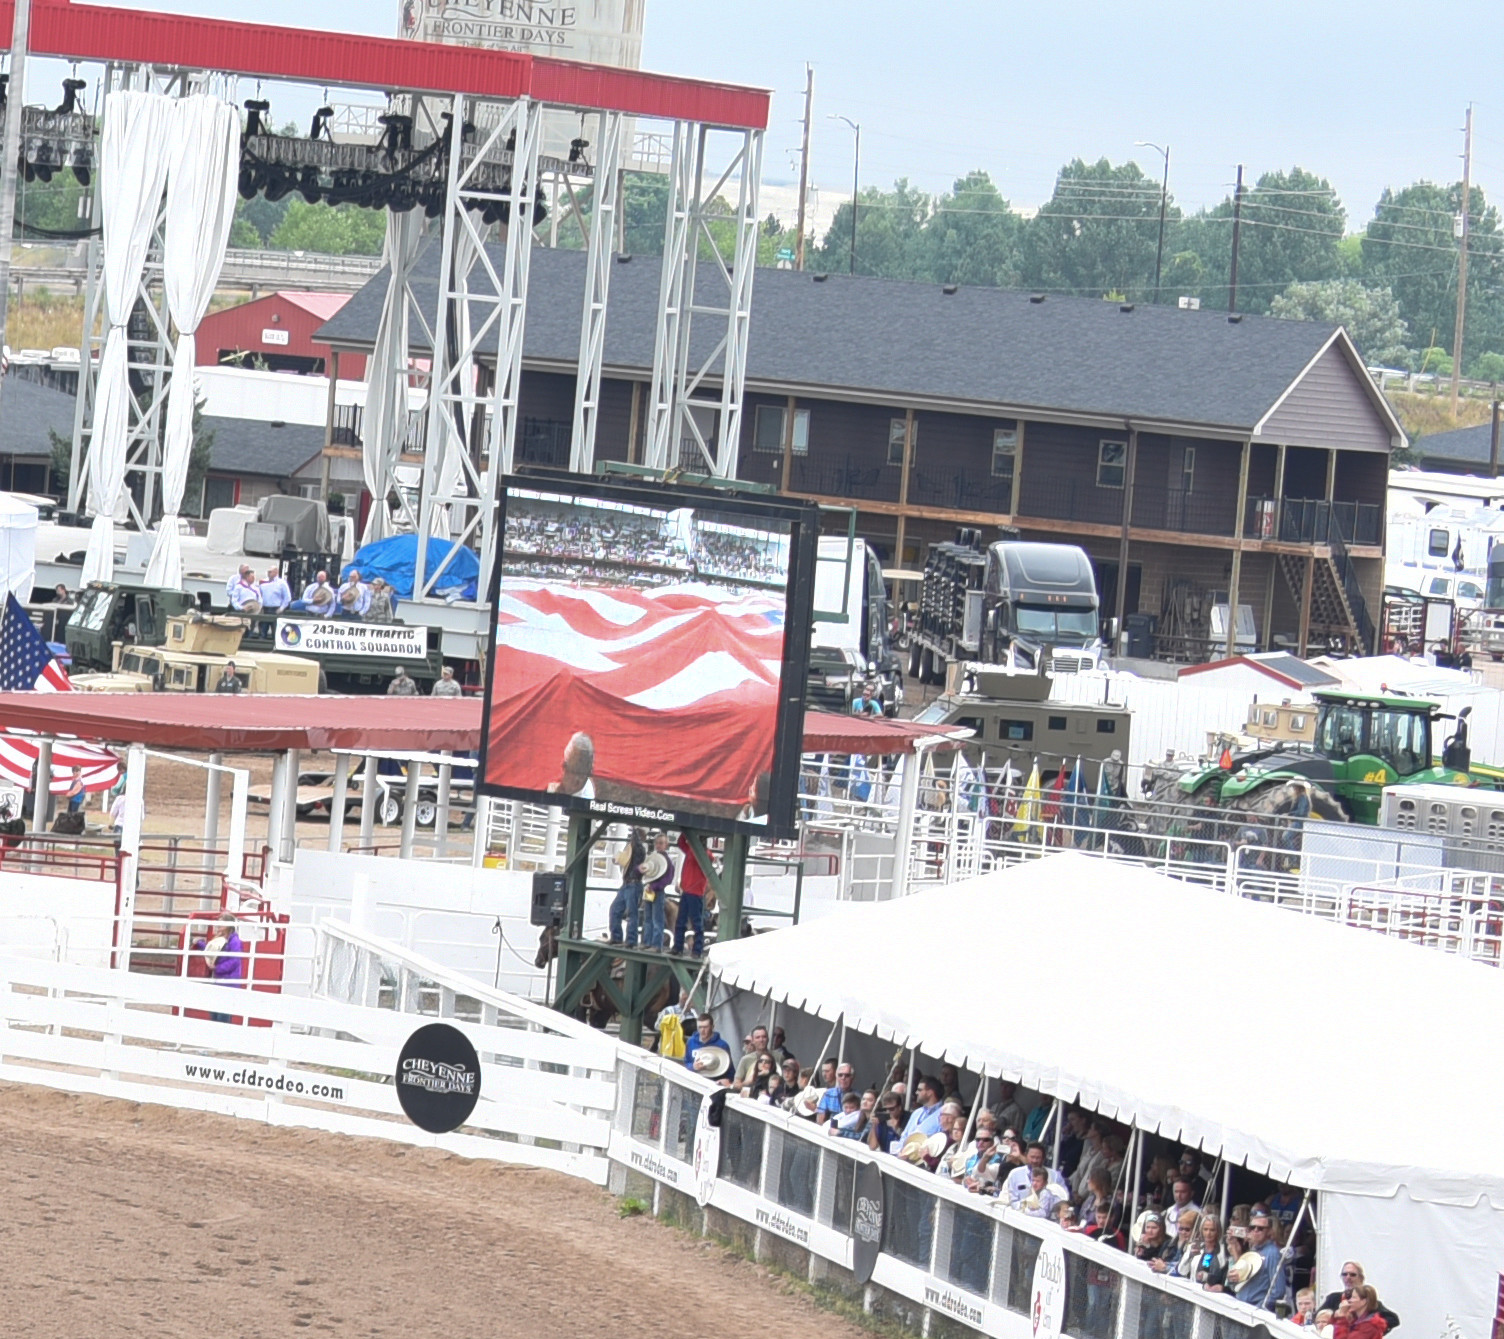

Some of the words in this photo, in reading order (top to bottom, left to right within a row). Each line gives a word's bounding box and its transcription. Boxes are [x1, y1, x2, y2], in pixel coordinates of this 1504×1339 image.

[433, 20, 515, 39] FRONTIER
[520, 28, 565, 44] DAYS
[347, 626, 367, 637] AIR
[370, 628, 415, 640] TRAFFIC
[306, 638, 357, 651] CONTROL
[360, 642, 422, 654] SQUADRON
[184, 1062, 344, 1100] www.cfdrodeo.com
[402, 1057, 476, 1084] CHEYENNE
[402, 1073, 447, 1091] FRONTIER
